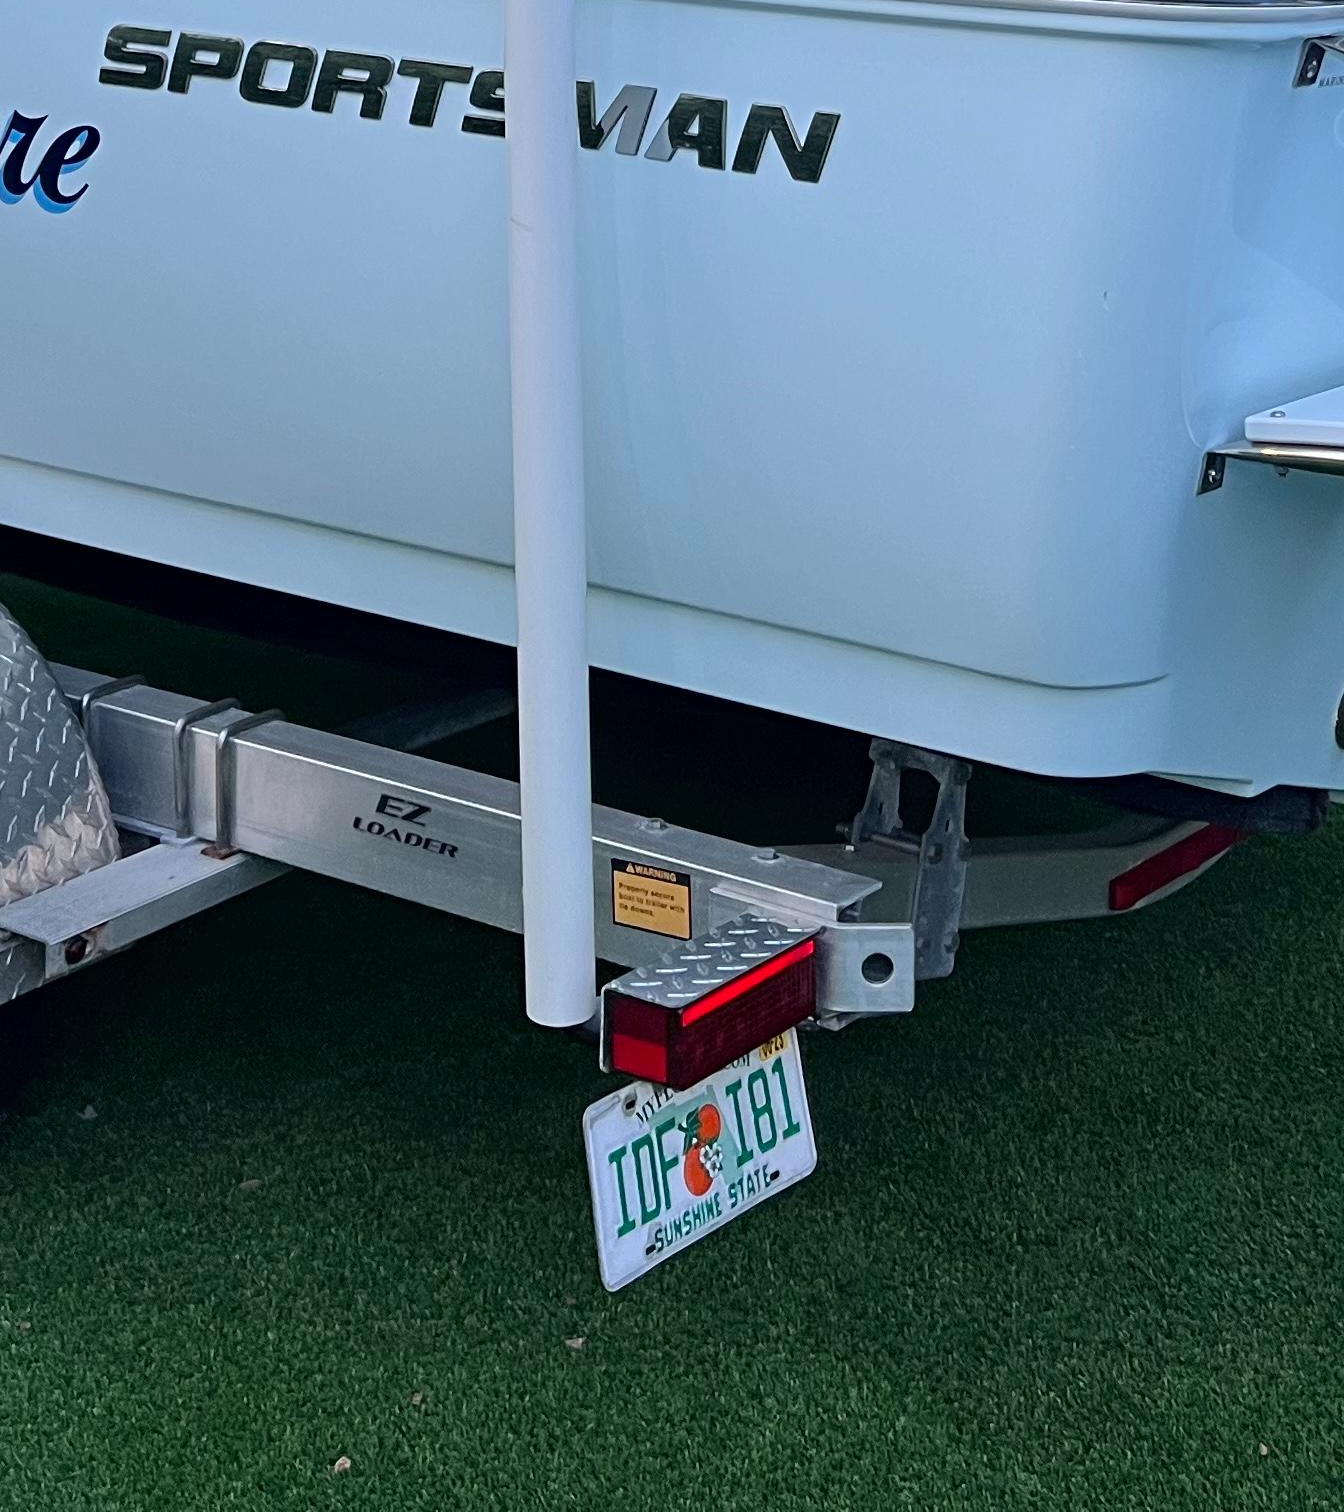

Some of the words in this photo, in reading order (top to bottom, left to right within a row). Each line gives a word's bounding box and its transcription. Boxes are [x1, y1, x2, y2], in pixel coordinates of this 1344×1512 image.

[375, 793, 432, 826] EZ
[353, 816, 459, 859] LOADER
[635, 864, 677, 882] WARNING
[608, 1117, 679, 1239] IDF
[725, 1055, 800, 1168] I81
[654, 1192, 722, 1253] SUNSHINE
[727, 1163, 771, 1209] STATE
